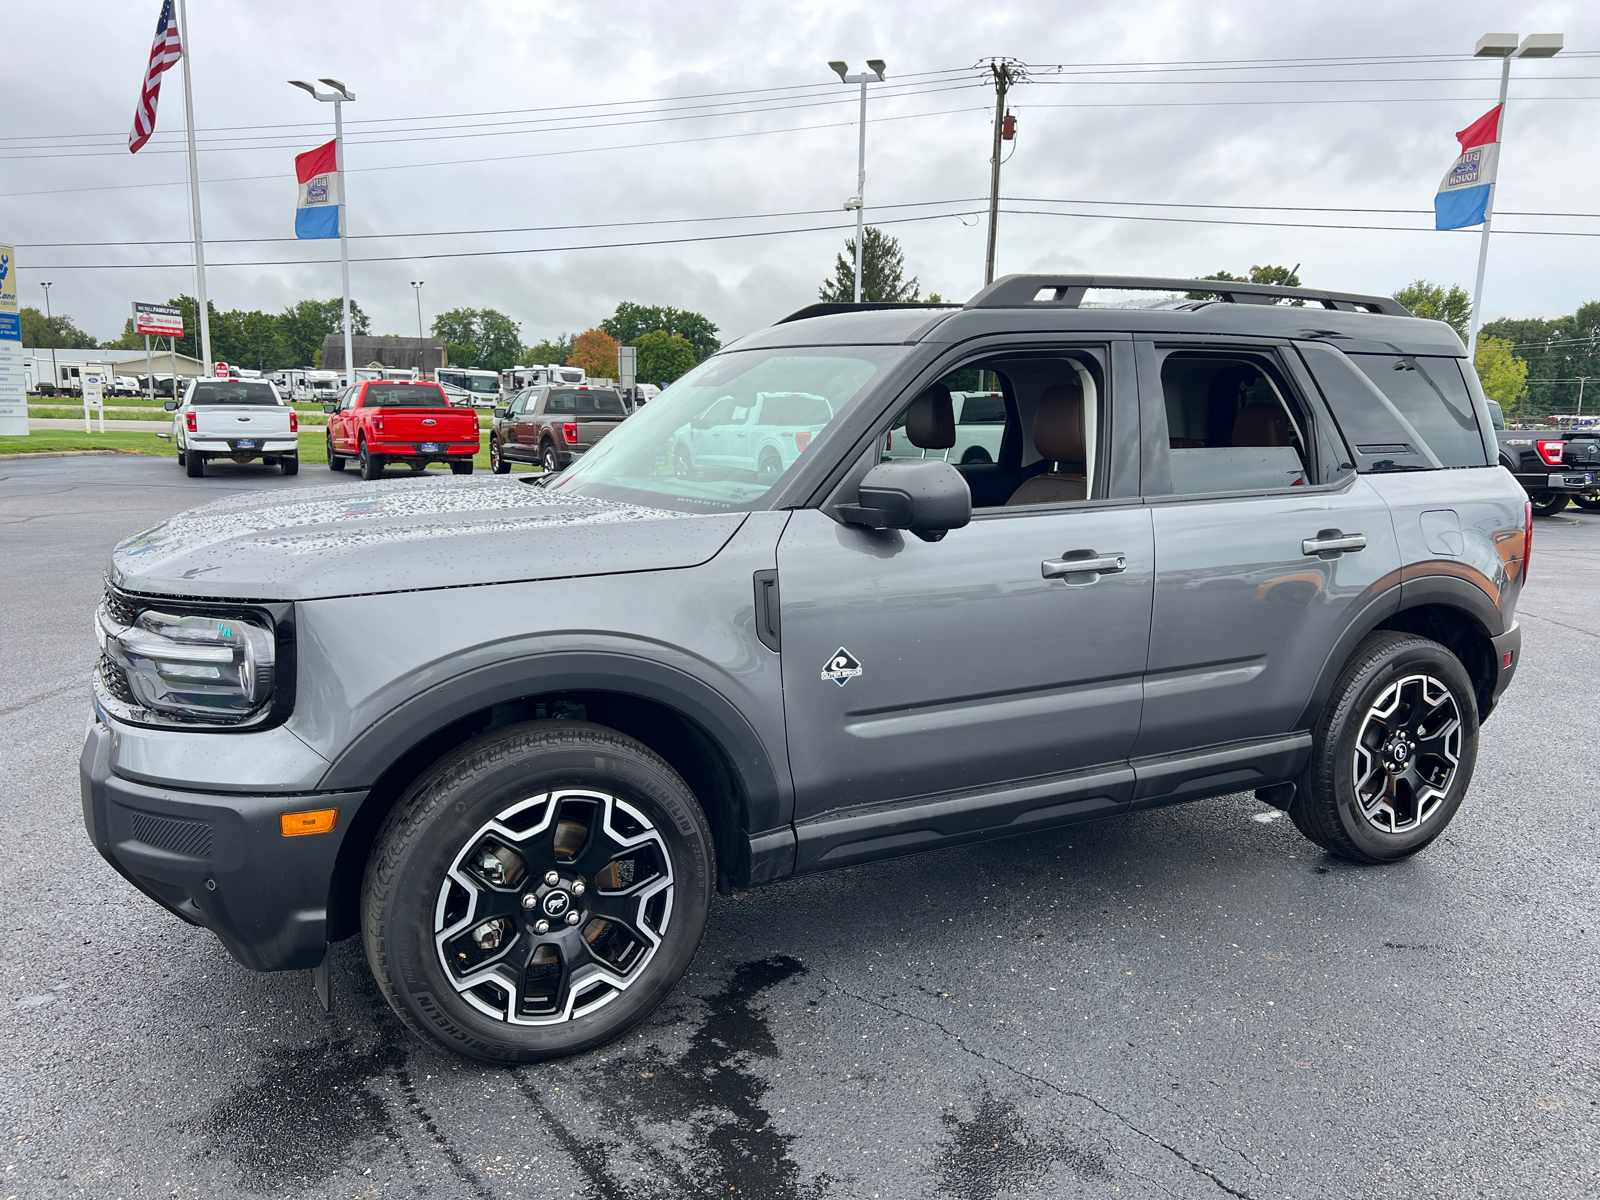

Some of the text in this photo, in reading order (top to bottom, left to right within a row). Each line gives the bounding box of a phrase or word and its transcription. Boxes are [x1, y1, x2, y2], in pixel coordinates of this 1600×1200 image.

[677, 497, 730, 508] BRONCO
[629, 774, 692, 832] MICHELIN
[692, 843, 705, 878] 225/60
[400, 936, 417, 983] PRIMACY
[417, 995, 490, 1051] MICHELIN
